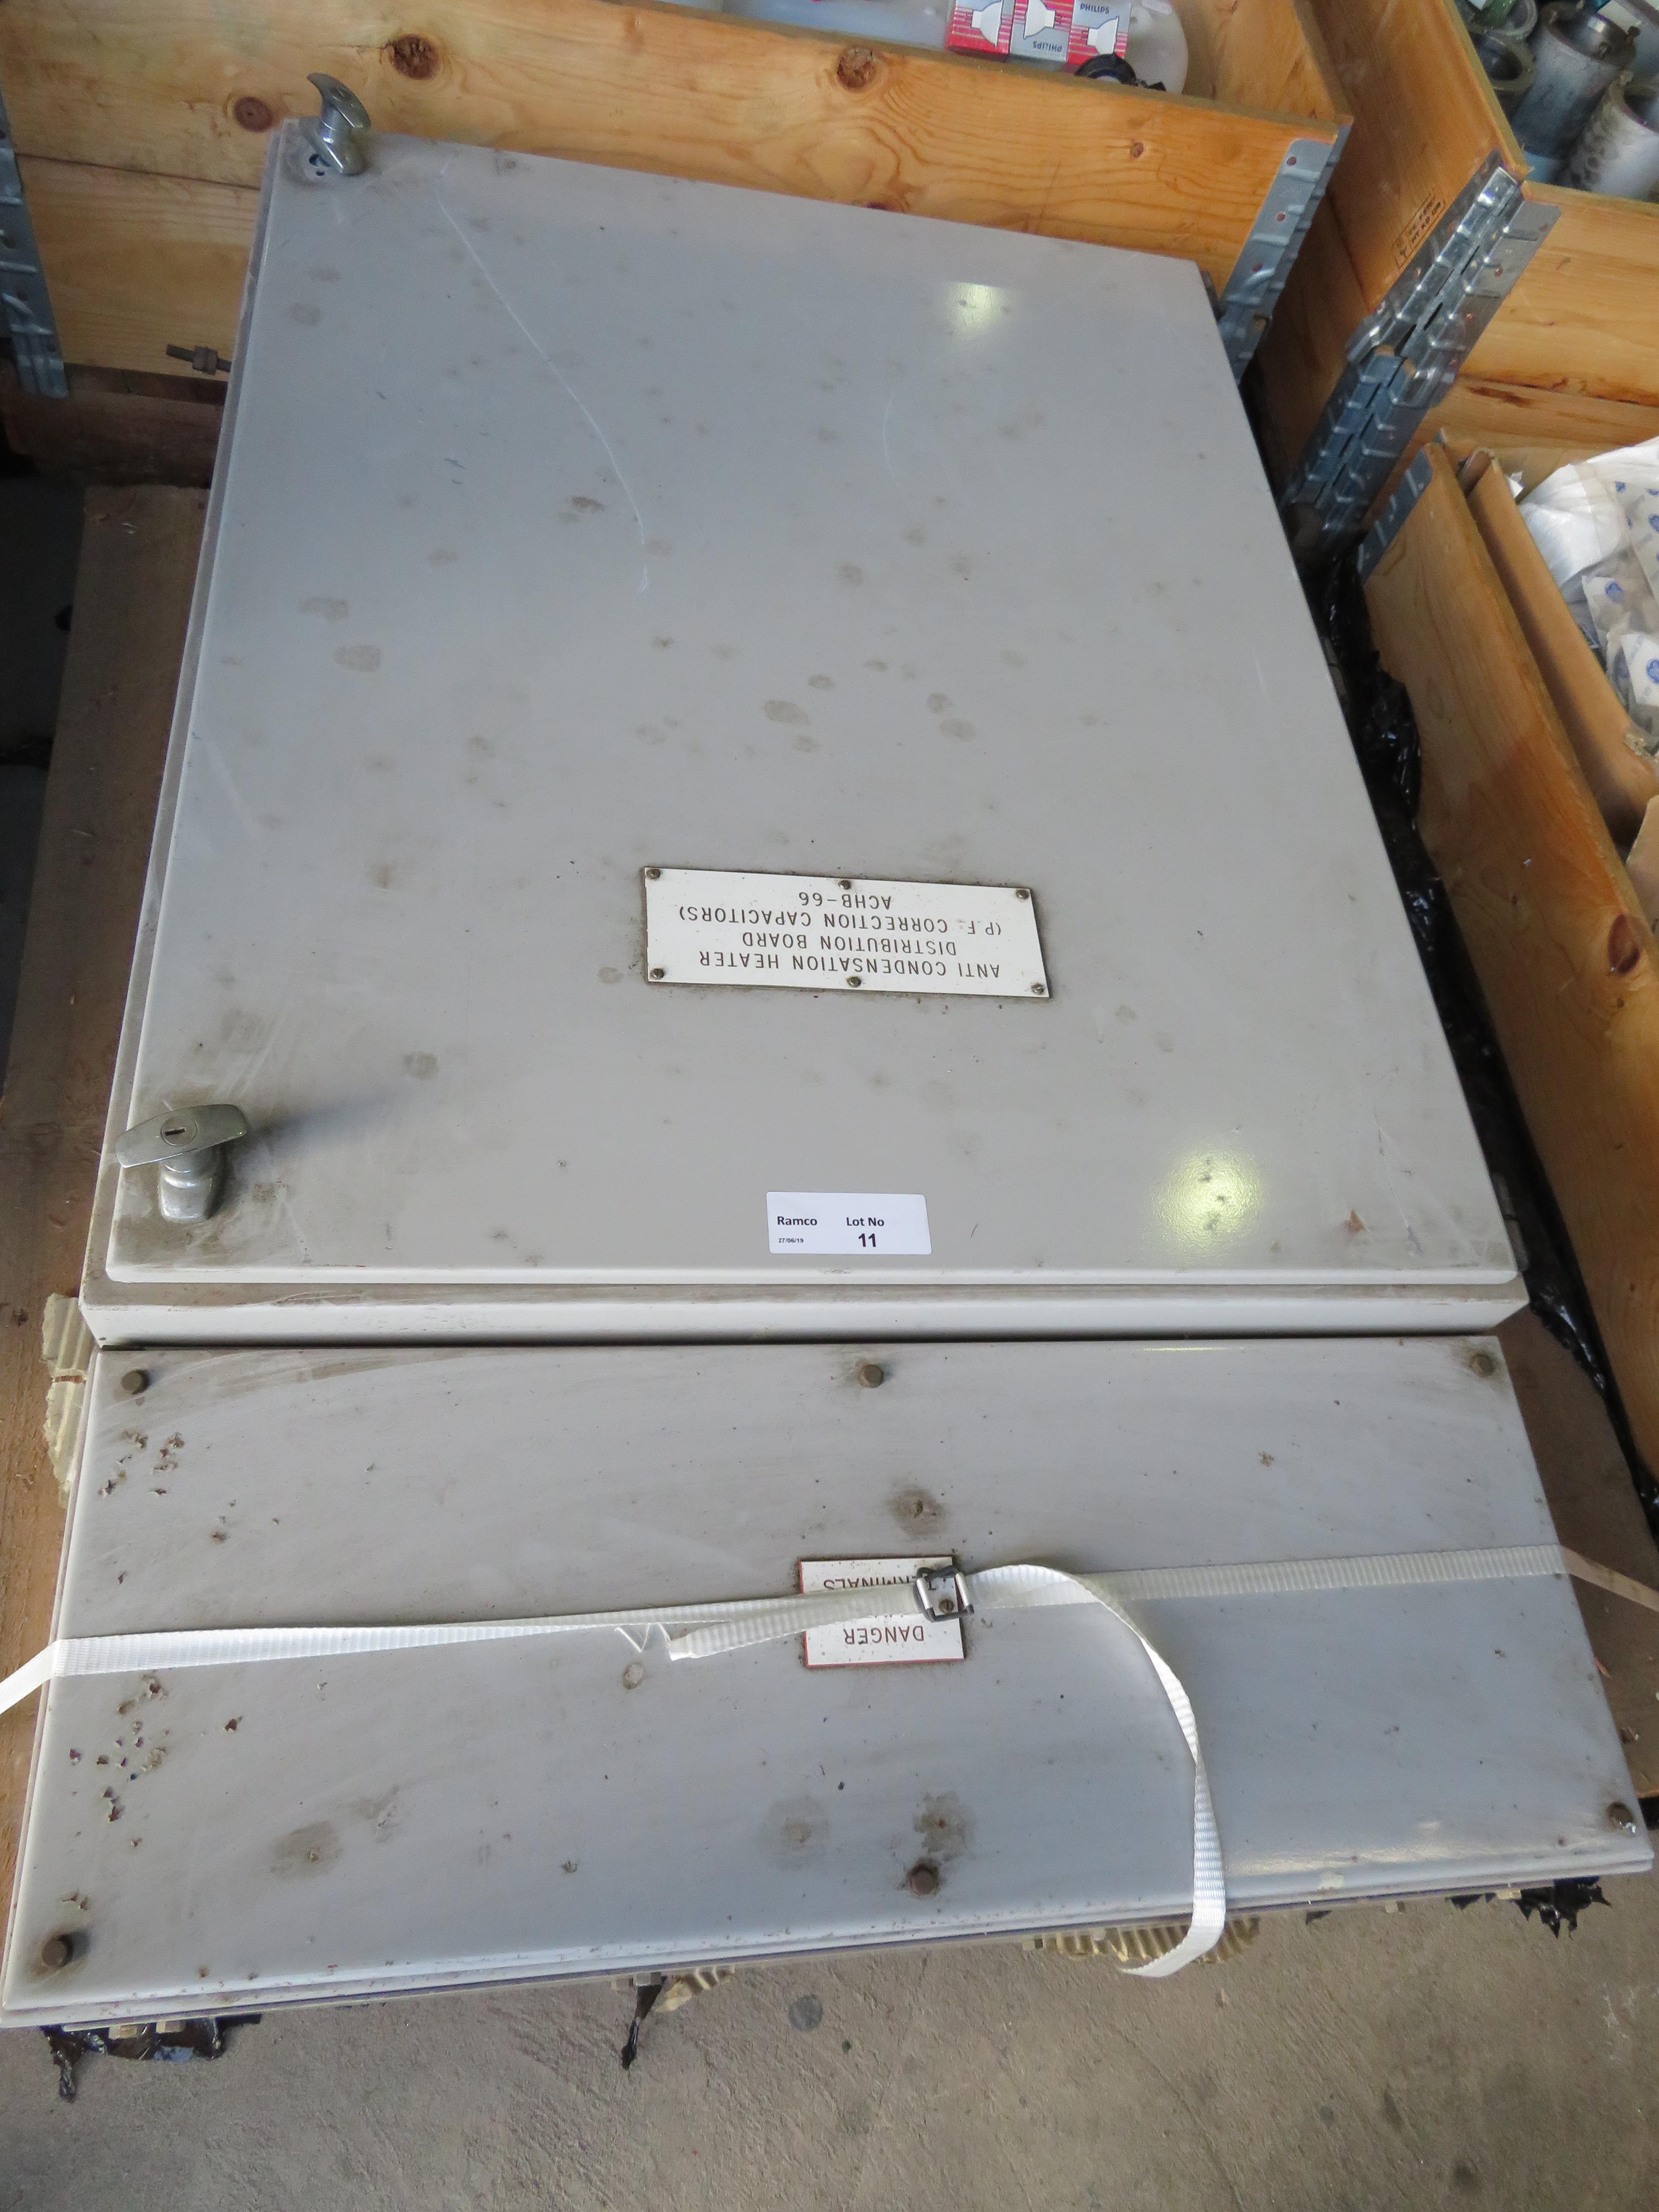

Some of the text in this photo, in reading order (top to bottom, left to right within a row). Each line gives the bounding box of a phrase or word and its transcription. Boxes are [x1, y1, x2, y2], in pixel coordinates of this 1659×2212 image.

[1080, 3, 1109, 14] PHILIPS
[1033, 41, 1062, 52] PHILIPS
[798, 892, 892, 910] ACHB-66
[679, 905, 811, 927] CAPACITORS)
[824, 913, 948, 933] CORRECTION
[742, 932, 957, 956] DISTRIBUTION BOARD
[699, 951, 1000, 978] ANTI CONDENSATION HEATER
[777, 1216, 818, 1226] Ramco
[846, 1217, 885, 1227] Lot No
[858, 1233, 876, 1248] 11
[843, 1625, 924, 1645] DANGER
